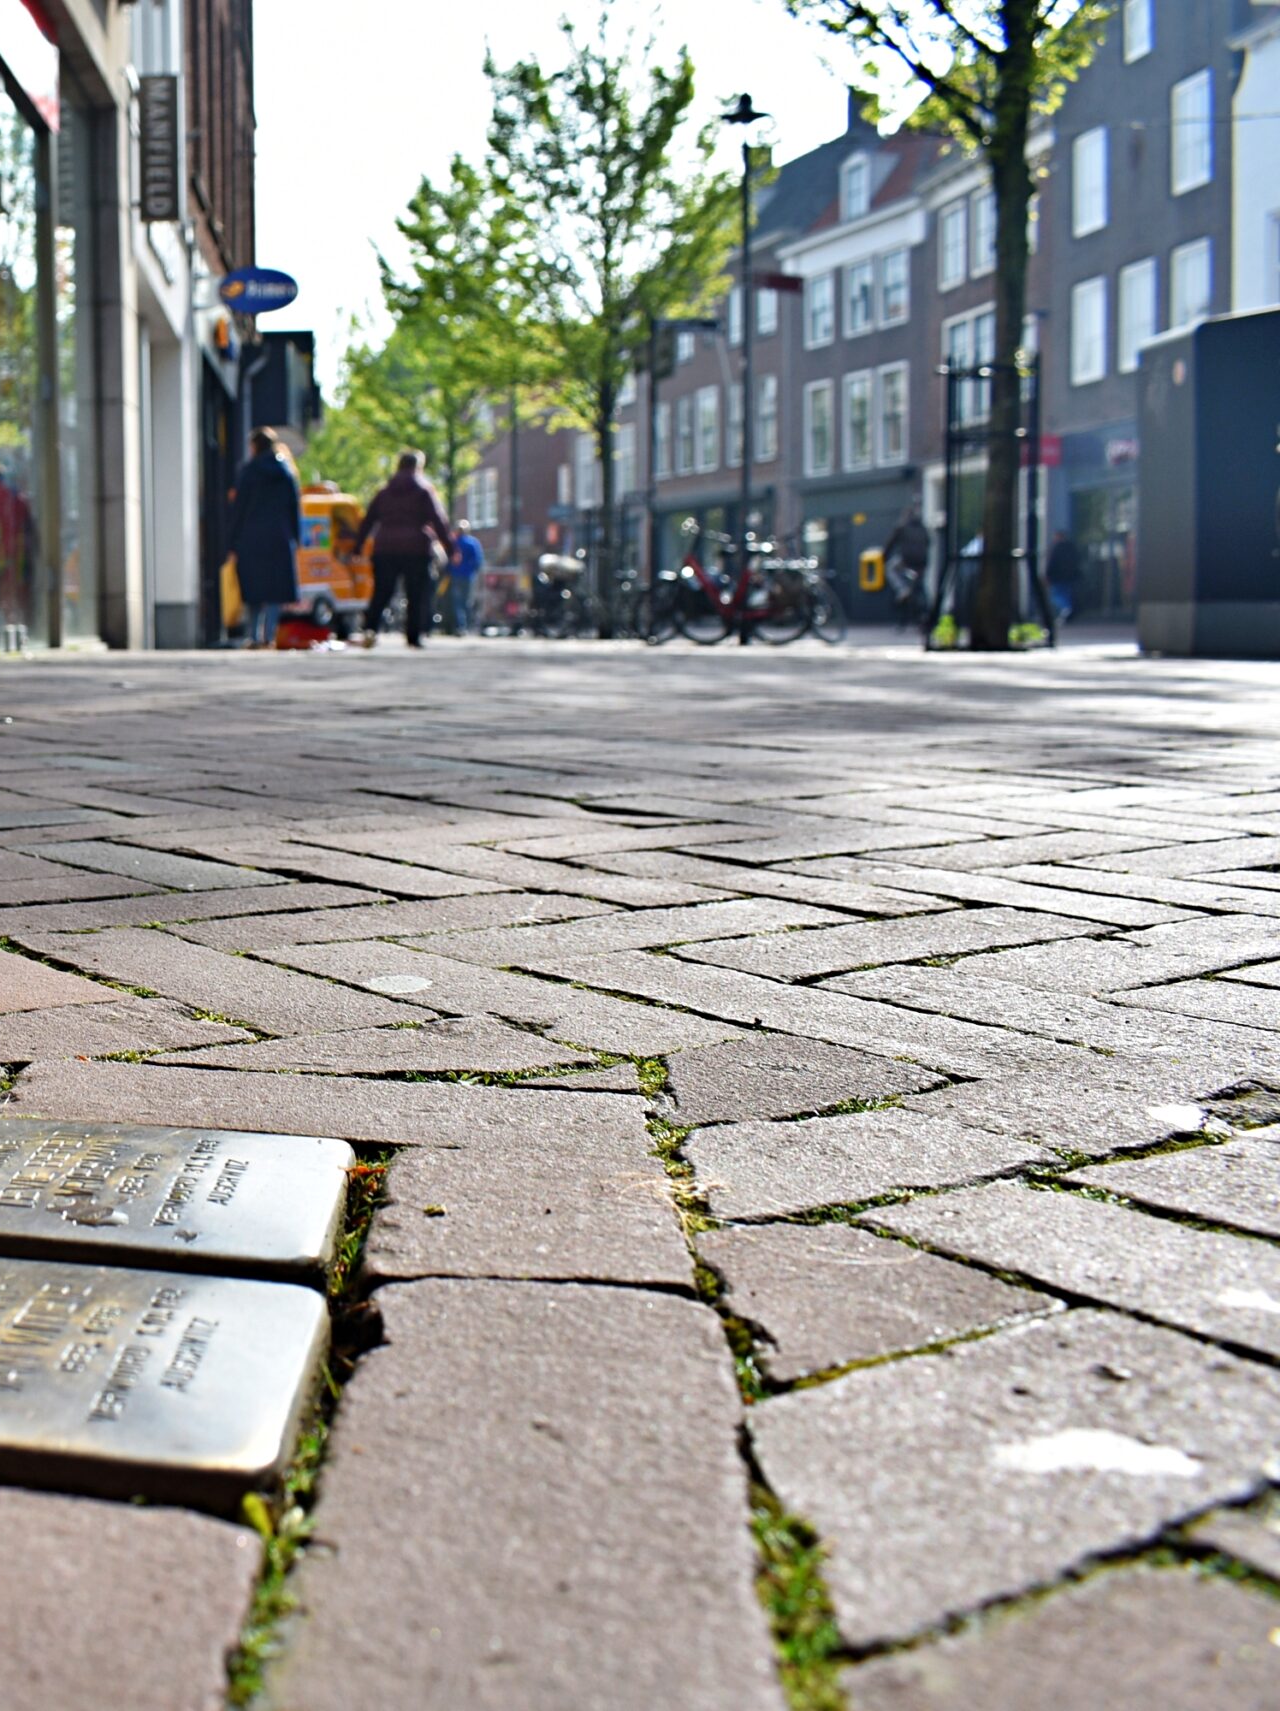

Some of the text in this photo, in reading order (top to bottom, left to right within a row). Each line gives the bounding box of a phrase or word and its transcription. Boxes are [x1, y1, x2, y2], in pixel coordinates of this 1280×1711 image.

[144, 1175, 202, 1228] VERMOORD
[202, 1158, 251, 1206] AUSCHWITZ
[153, 1315, 221, 1392] AUSCHWITZ
